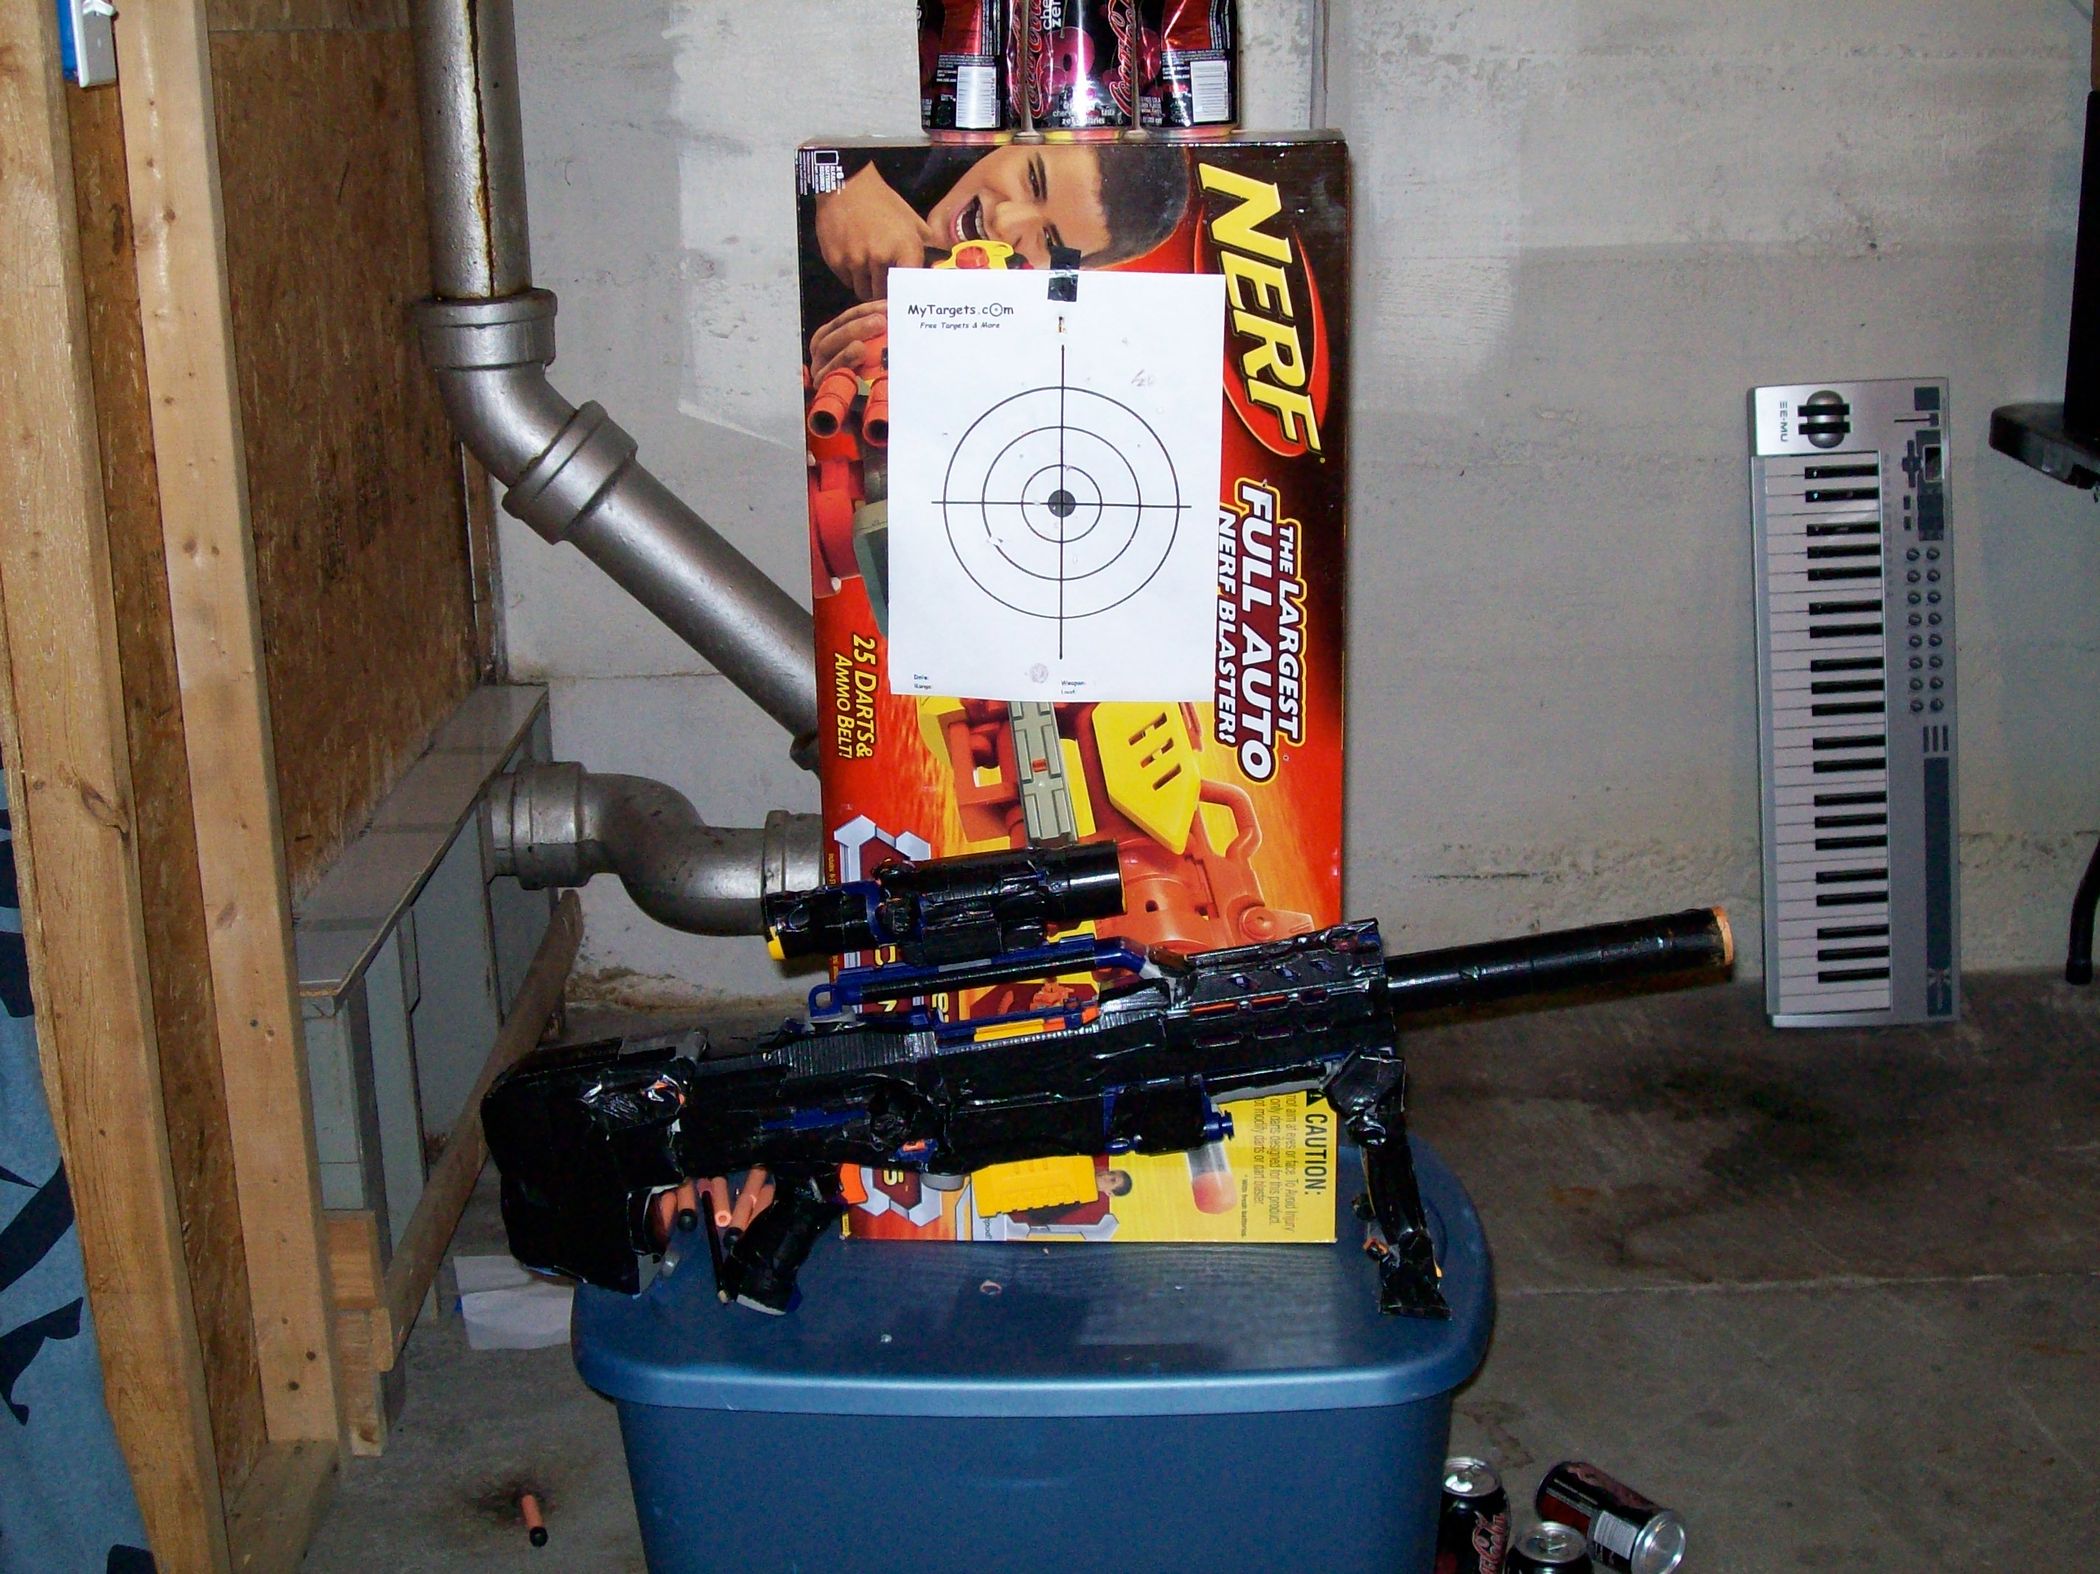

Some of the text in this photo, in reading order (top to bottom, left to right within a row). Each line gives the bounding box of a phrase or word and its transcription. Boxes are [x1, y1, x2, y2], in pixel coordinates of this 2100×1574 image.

[941, 322, 969, 330] Targets
[1198, 162, 1322, 454] NERF
[853, 633, 877, 667] 25
[1217, 509, 1237, 742] NERF BLASTER!
[1241, 484, 1273, 779] FULL AUTO
[1277, 526, 1300, 740] THE LARGEST
[834, 653, 855, 759] AMMO BELT!
[1304, 1114, 1328, 1196] CAUTION:
